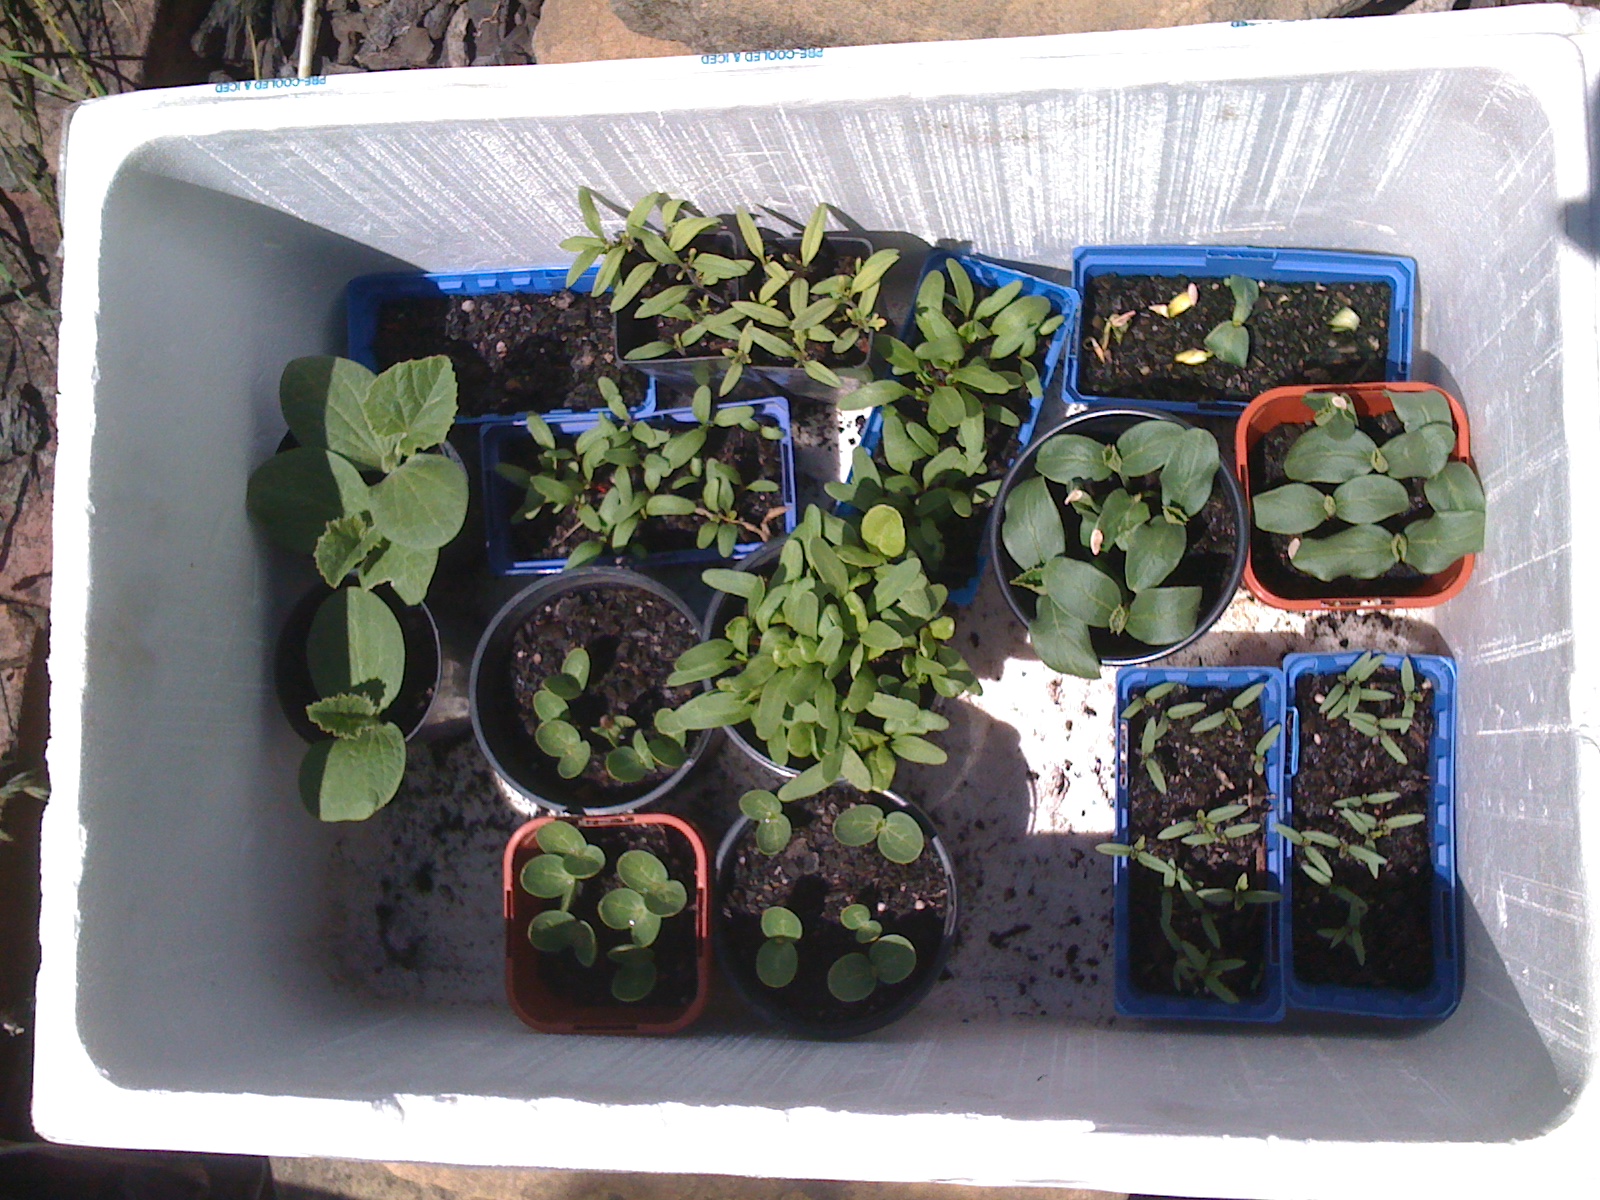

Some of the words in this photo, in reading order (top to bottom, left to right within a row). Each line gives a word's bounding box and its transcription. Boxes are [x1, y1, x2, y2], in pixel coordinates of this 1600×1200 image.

[701, 54, 729, 64] ICED
[745, 48, 823, 62] PRE-COOLED
[215, 82, 240, 93] ICED
[254, 76, 326, 90] PRE-COOLED
